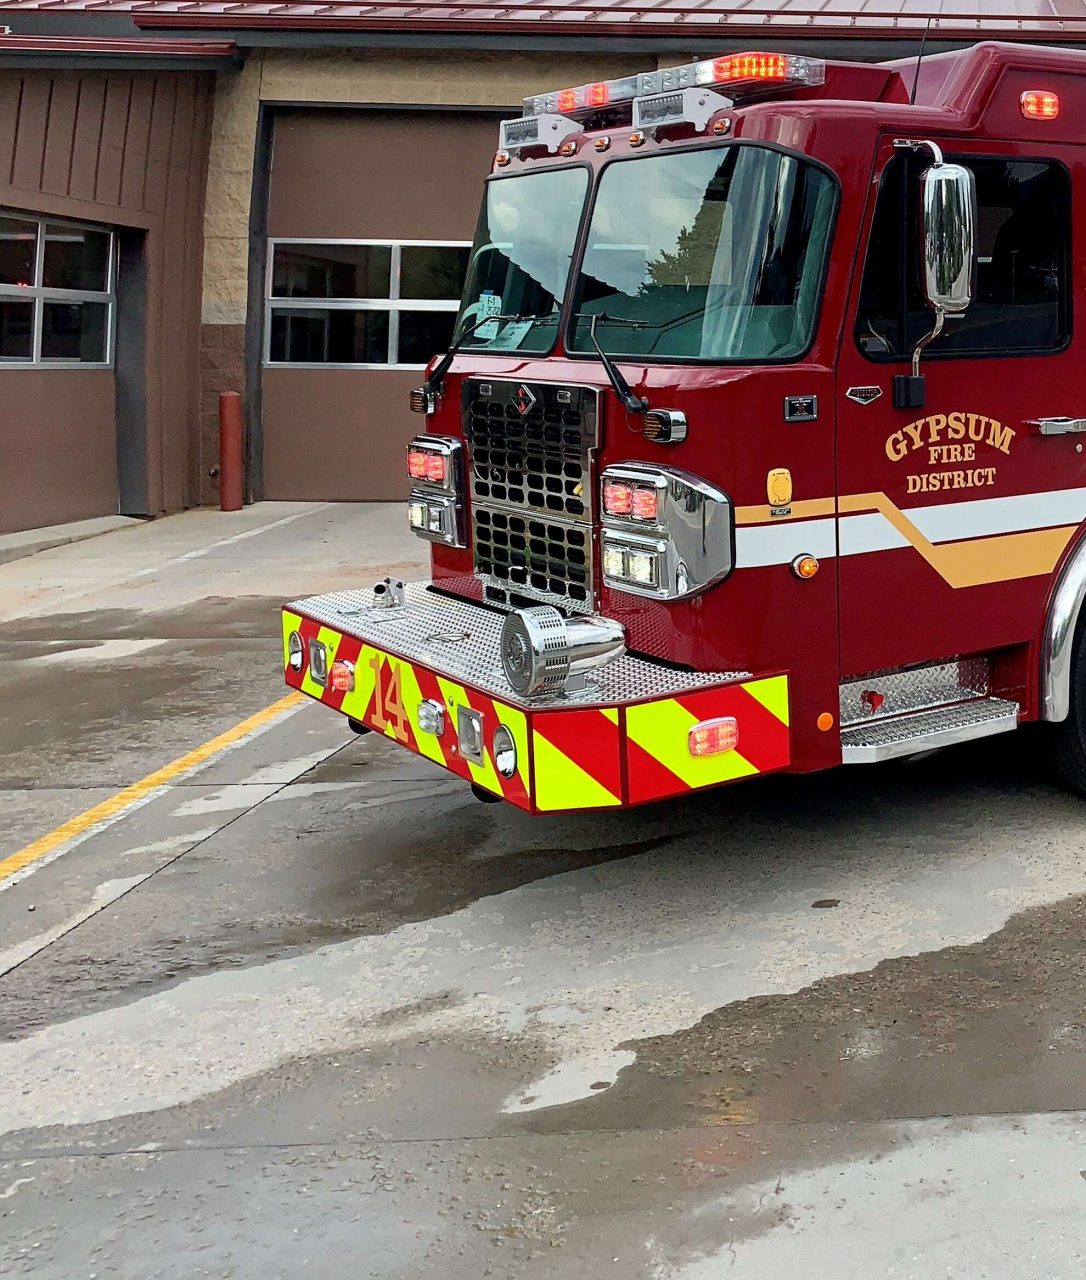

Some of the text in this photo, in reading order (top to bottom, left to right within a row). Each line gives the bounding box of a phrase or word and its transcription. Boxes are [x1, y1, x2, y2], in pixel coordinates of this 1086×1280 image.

[885, 412, 1016, 462] GYPSUM
[928, 443, 976, 464] FIRE
[906, 467, 996, 493] DISTRICT
[369, 653, 409, 743] 14
